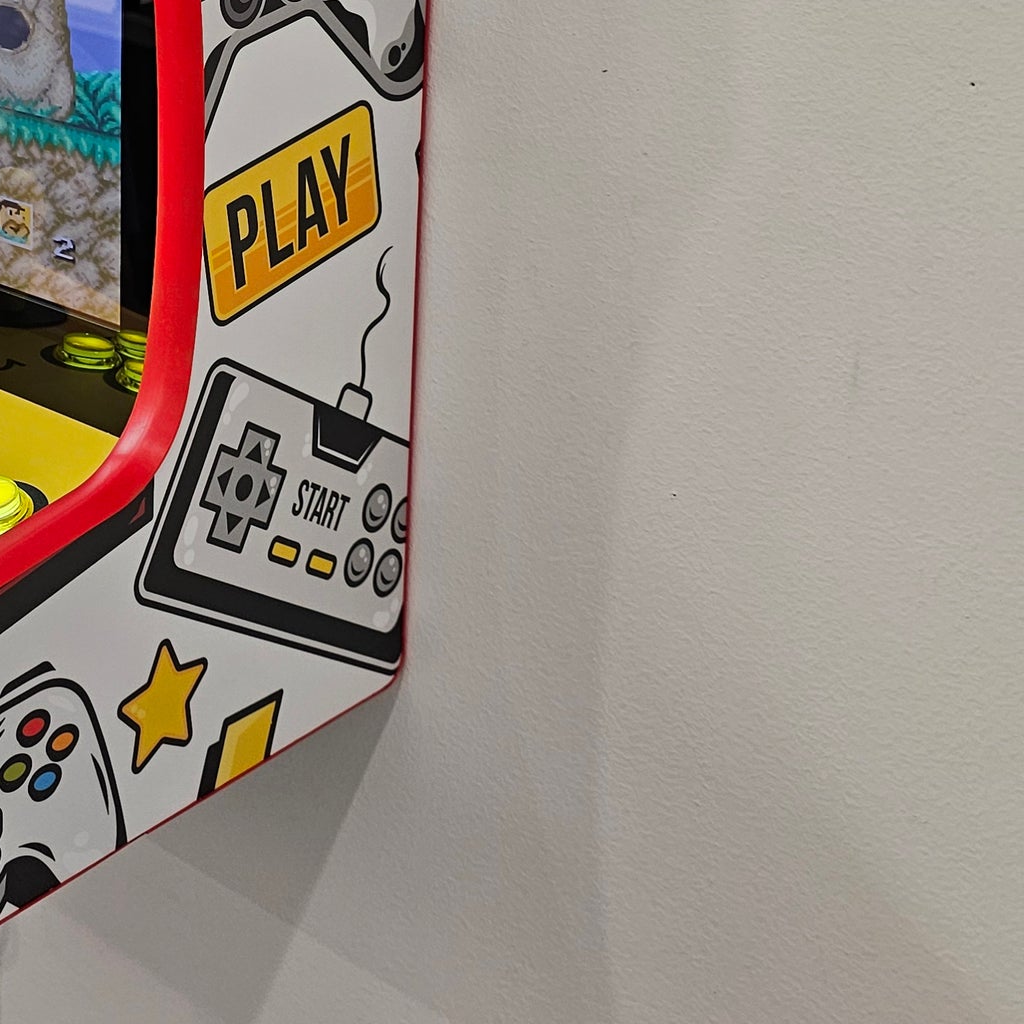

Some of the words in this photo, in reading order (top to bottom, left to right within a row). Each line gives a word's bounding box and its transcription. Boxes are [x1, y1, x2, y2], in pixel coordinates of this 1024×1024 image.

[226, 134, 351, 290] PLAY
[53, 236, 76, 264] 2
[292, 479, 351, 532] START
